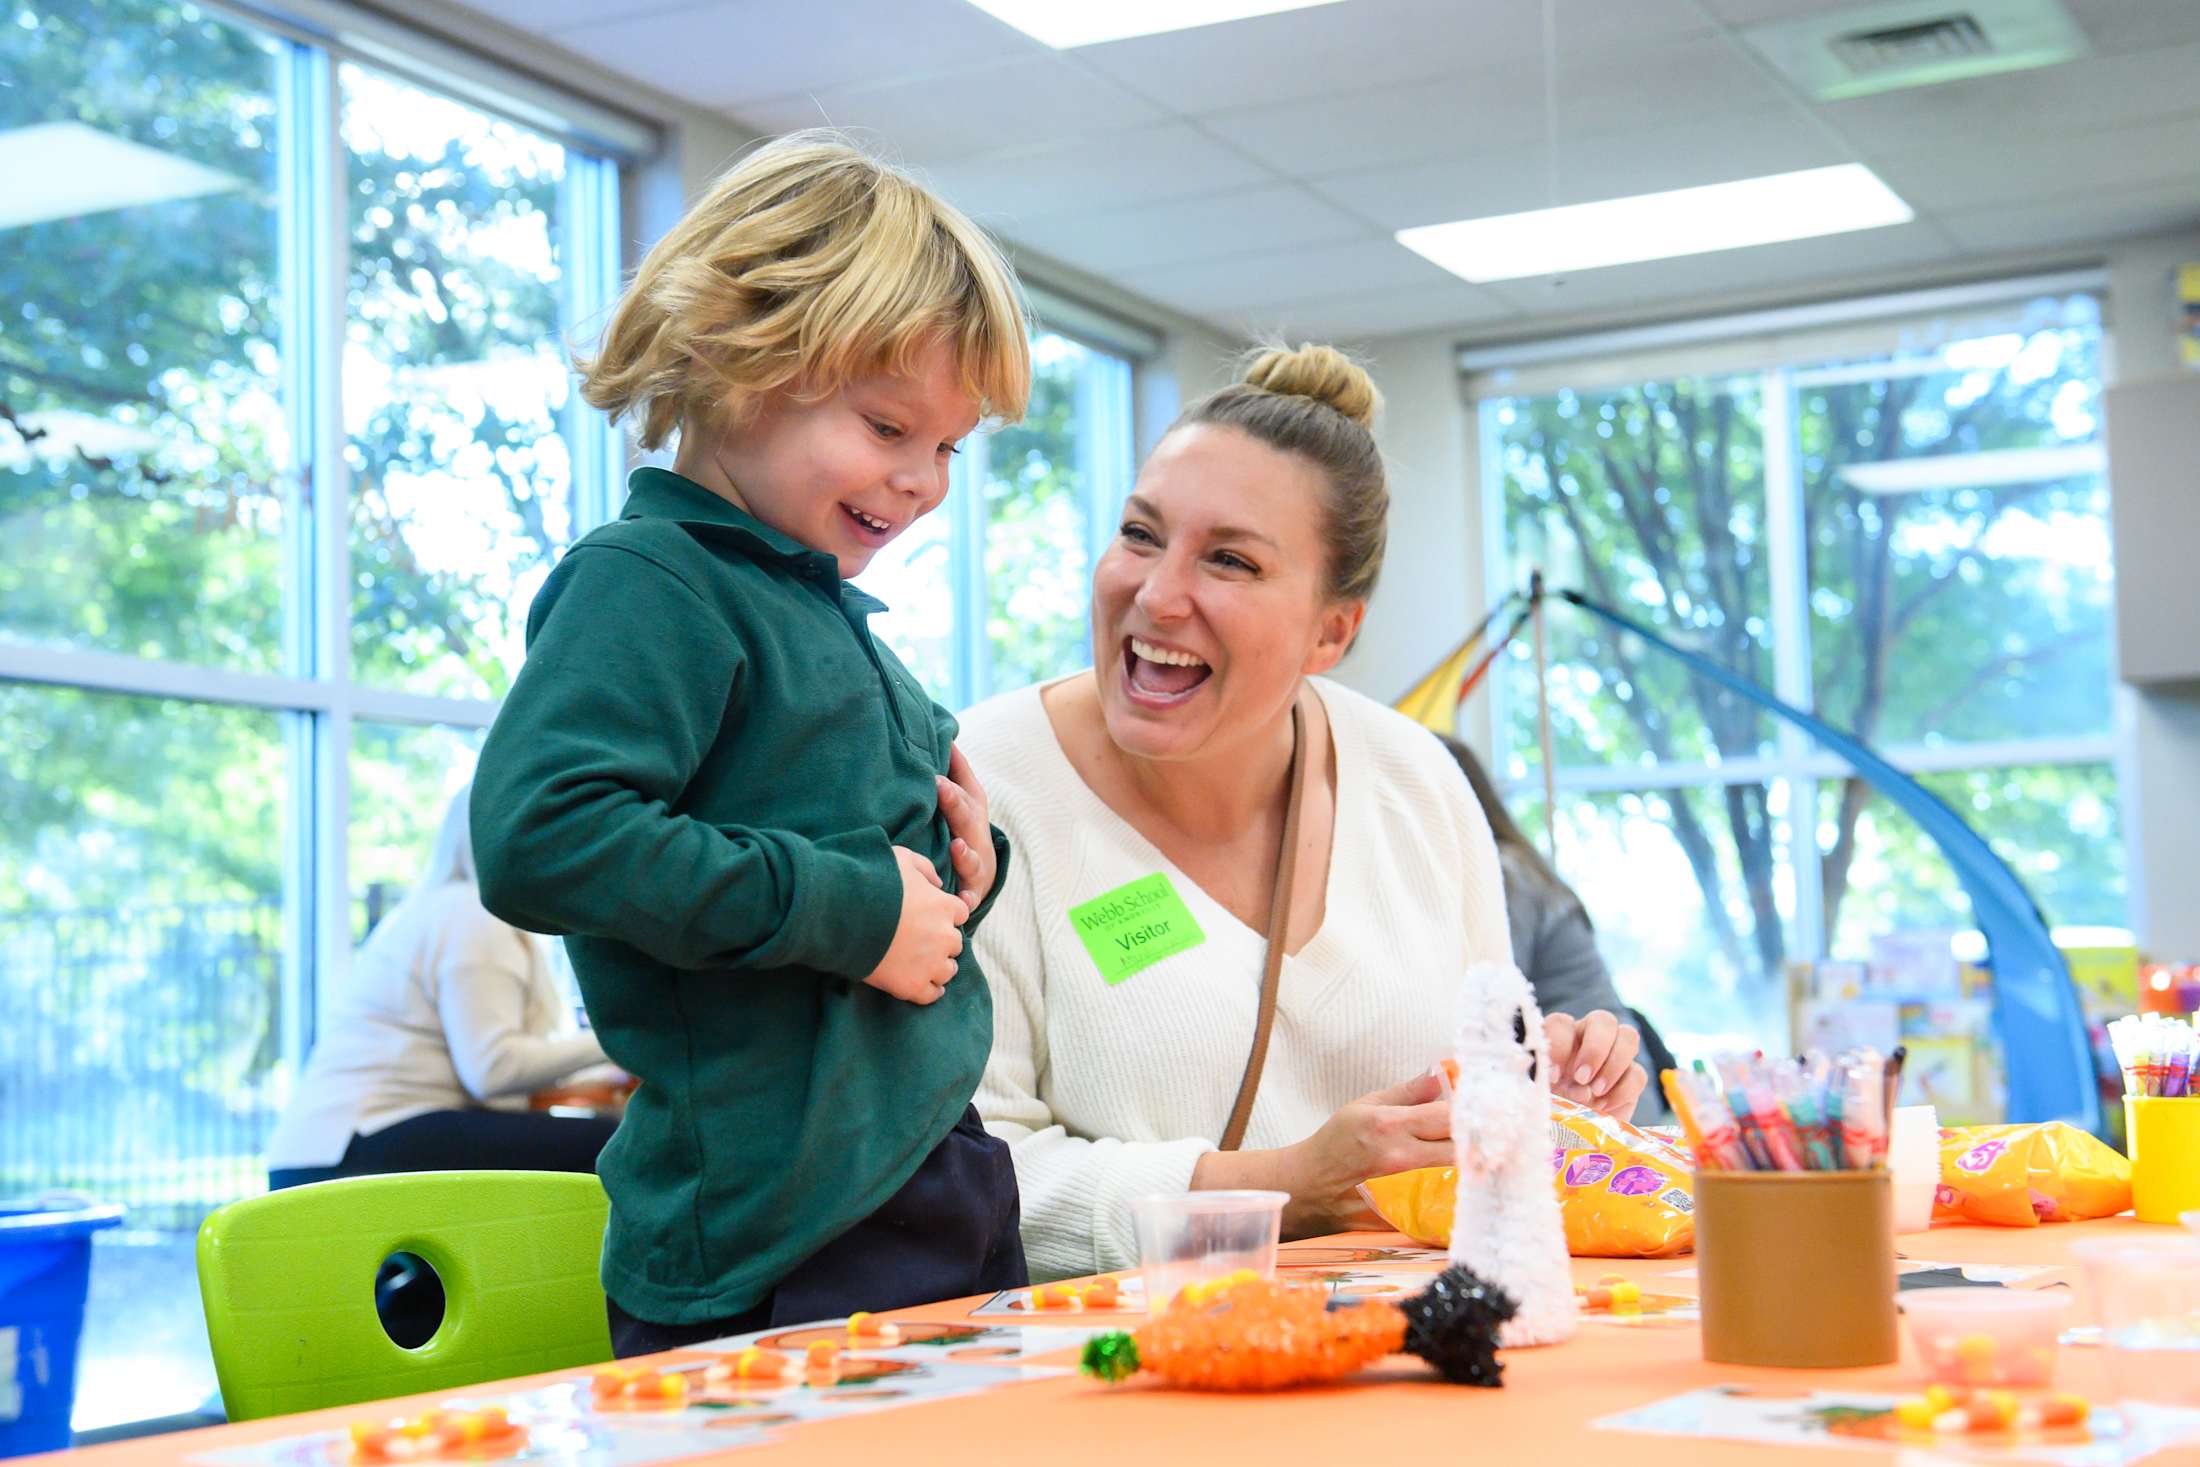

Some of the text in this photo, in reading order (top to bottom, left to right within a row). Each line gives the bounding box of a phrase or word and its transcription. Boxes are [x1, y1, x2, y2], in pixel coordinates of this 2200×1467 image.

[1080, 883, 1169, 930] Webb School
[1115, 920, 1171, 951] Visitor
